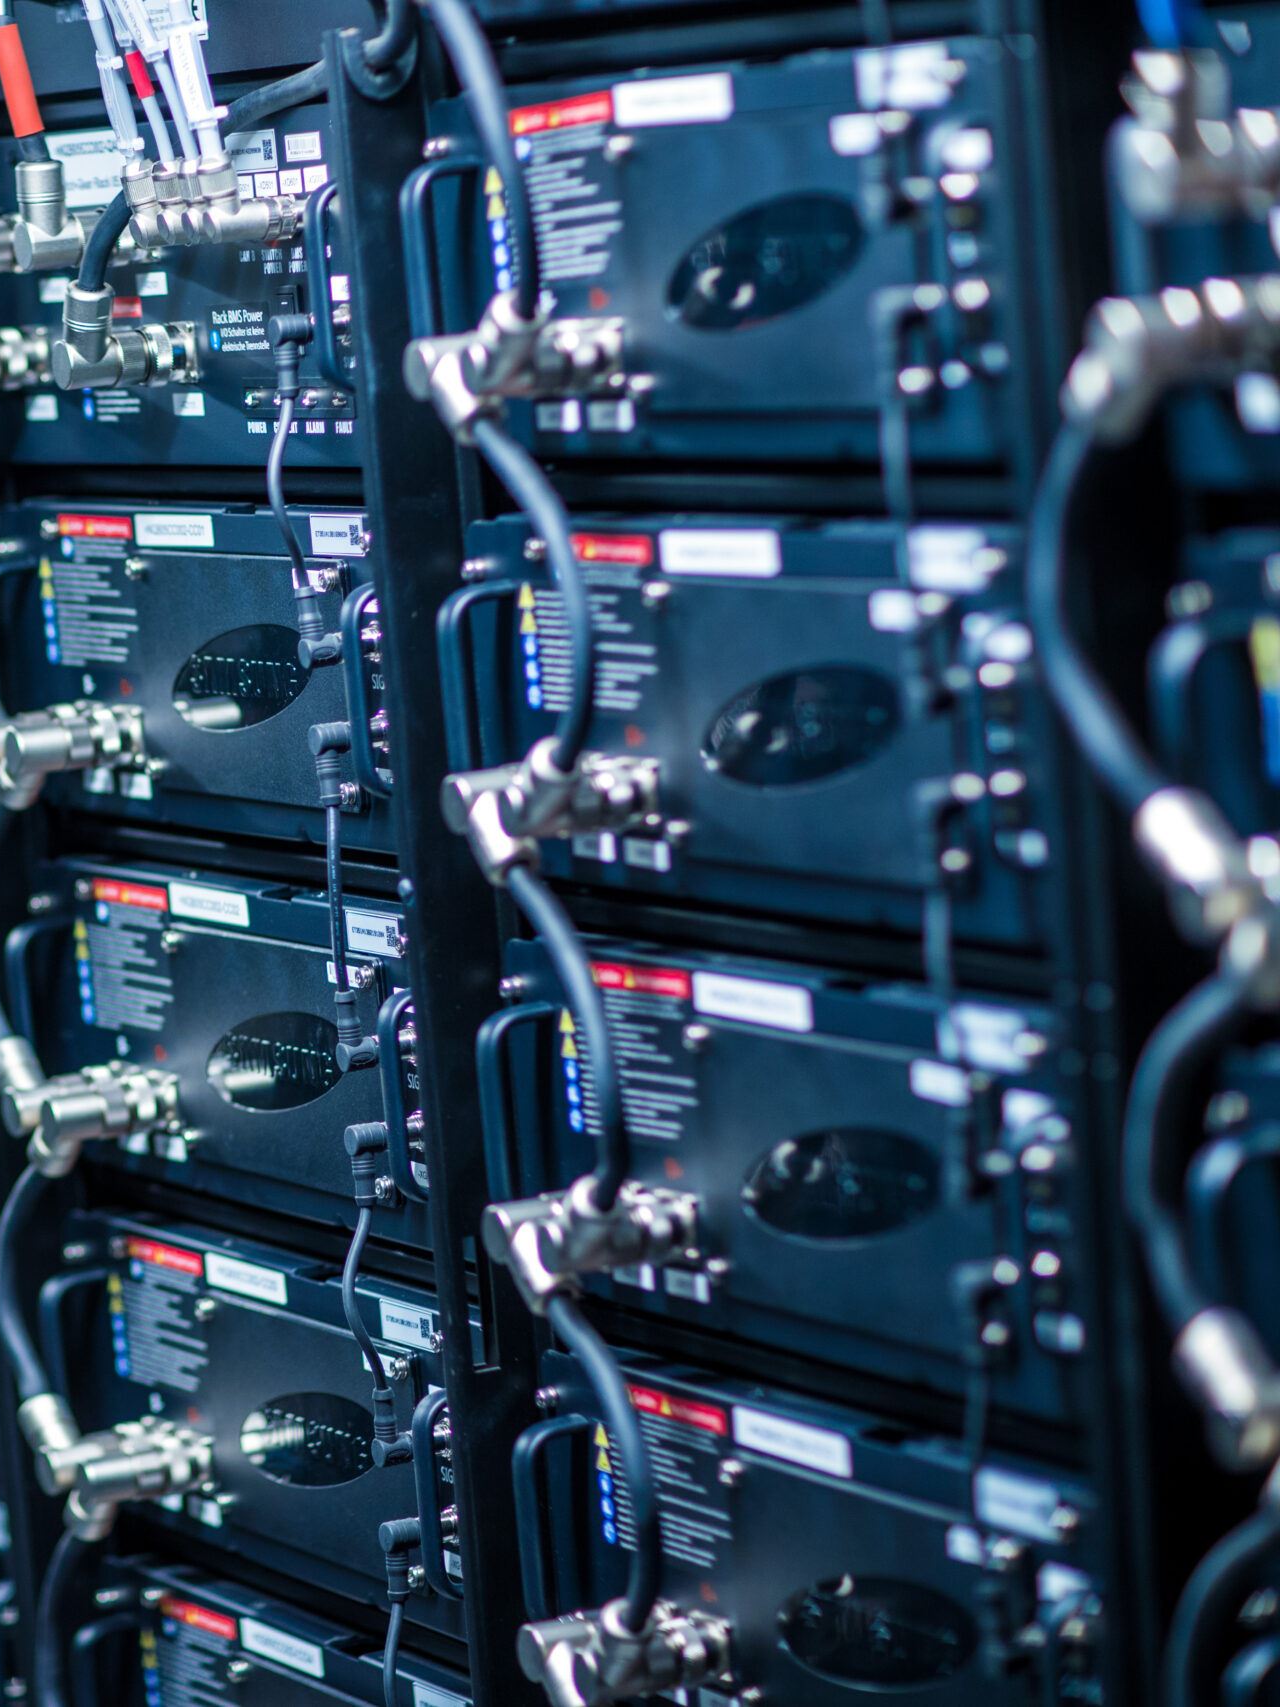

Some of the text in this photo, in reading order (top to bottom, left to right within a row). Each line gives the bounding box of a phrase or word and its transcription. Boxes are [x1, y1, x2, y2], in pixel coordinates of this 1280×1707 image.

[261, 248, 282, 260] SWITCH
[264, 262, 283, 274] POWER
[288, 260, 308, 273] POWER
[212, 309, 263, 324] Rack BMS Power
[247, 421, 268, 434] POWER
[305, 421, 325, 434] ALARM
[335, 421, 353, 434] FAULT
[407, 1072, 420, 1090] SIG
[440, 1465, 455, 1484] SIG
